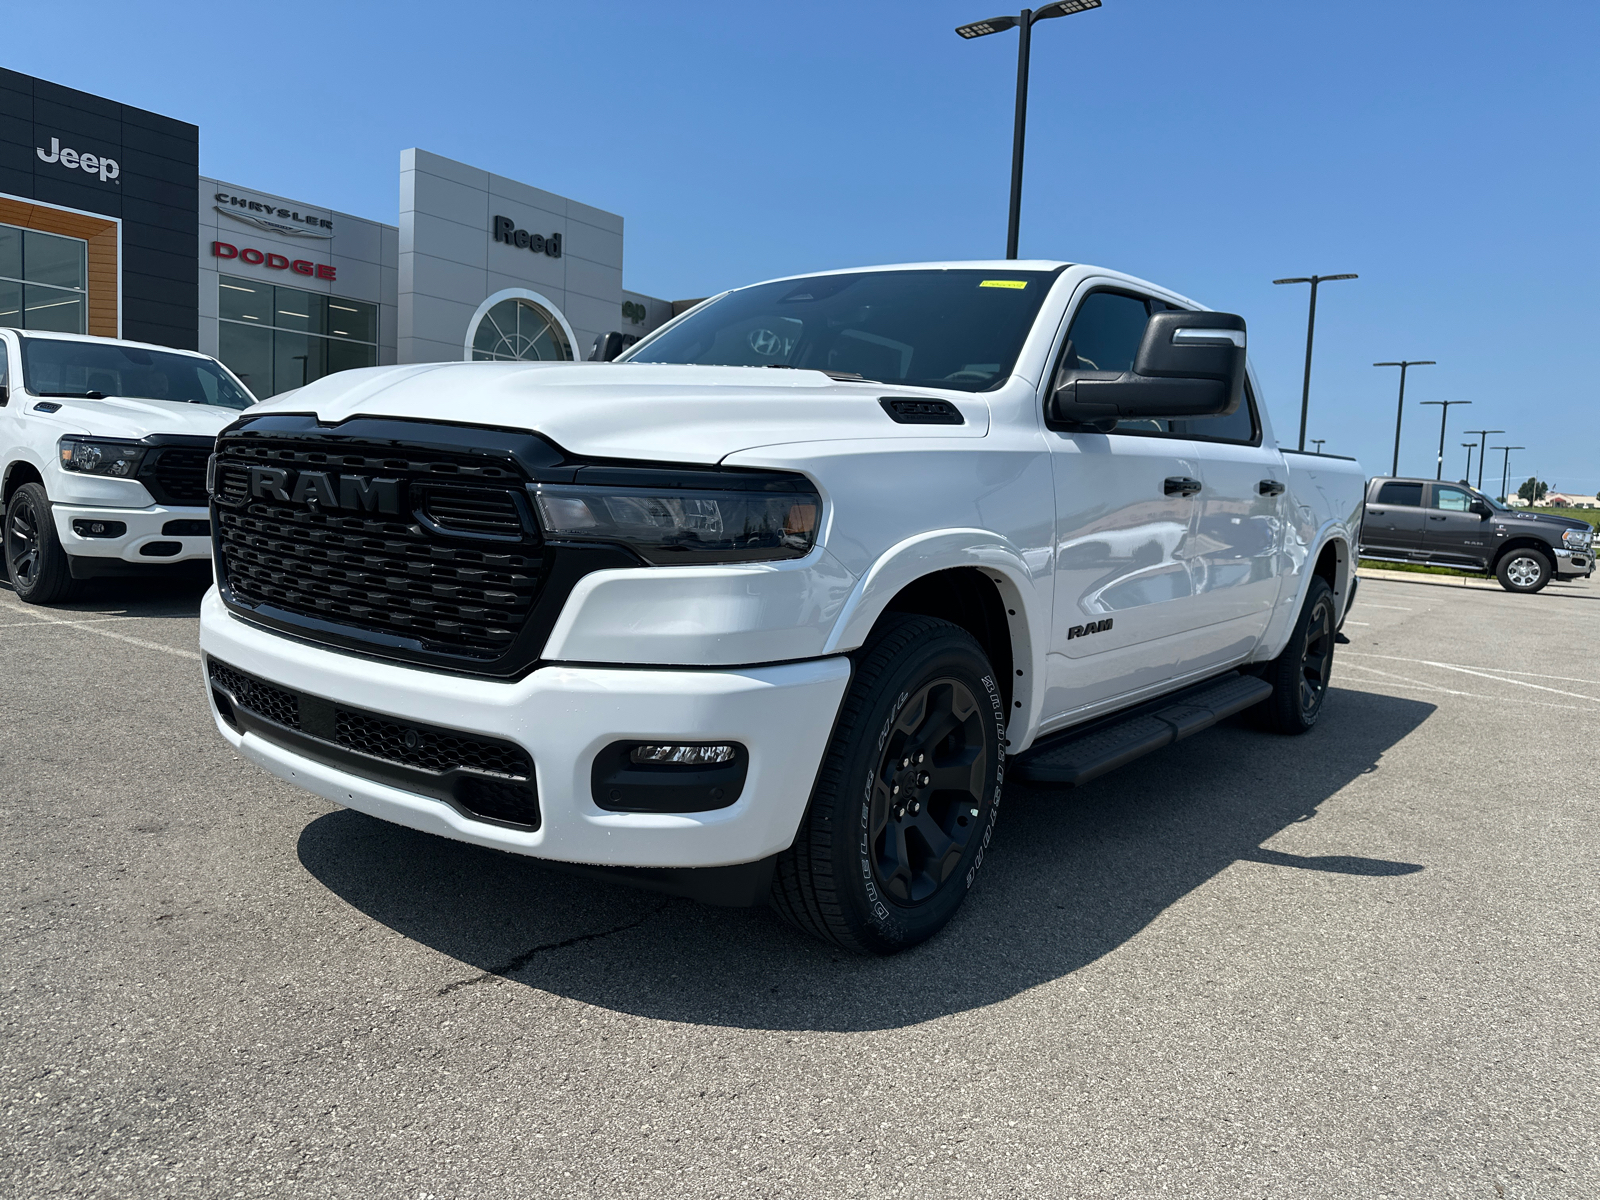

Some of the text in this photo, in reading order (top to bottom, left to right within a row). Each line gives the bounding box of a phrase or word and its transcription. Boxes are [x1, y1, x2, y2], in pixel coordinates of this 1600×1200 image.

[36, 137, 120, 182] Jeep
[214, 192, 334, 230] CHRYSLER
[494, 214, 562, 258] Reed
[212, 240, 337, 282] DODGE
[249, 465, 400, 515] RAM
[1067, 618, 1114, 640] RAM
[966, 674, 1006, 889] BRIDGESTONE
[860, 770, 890, 920] DUELER
